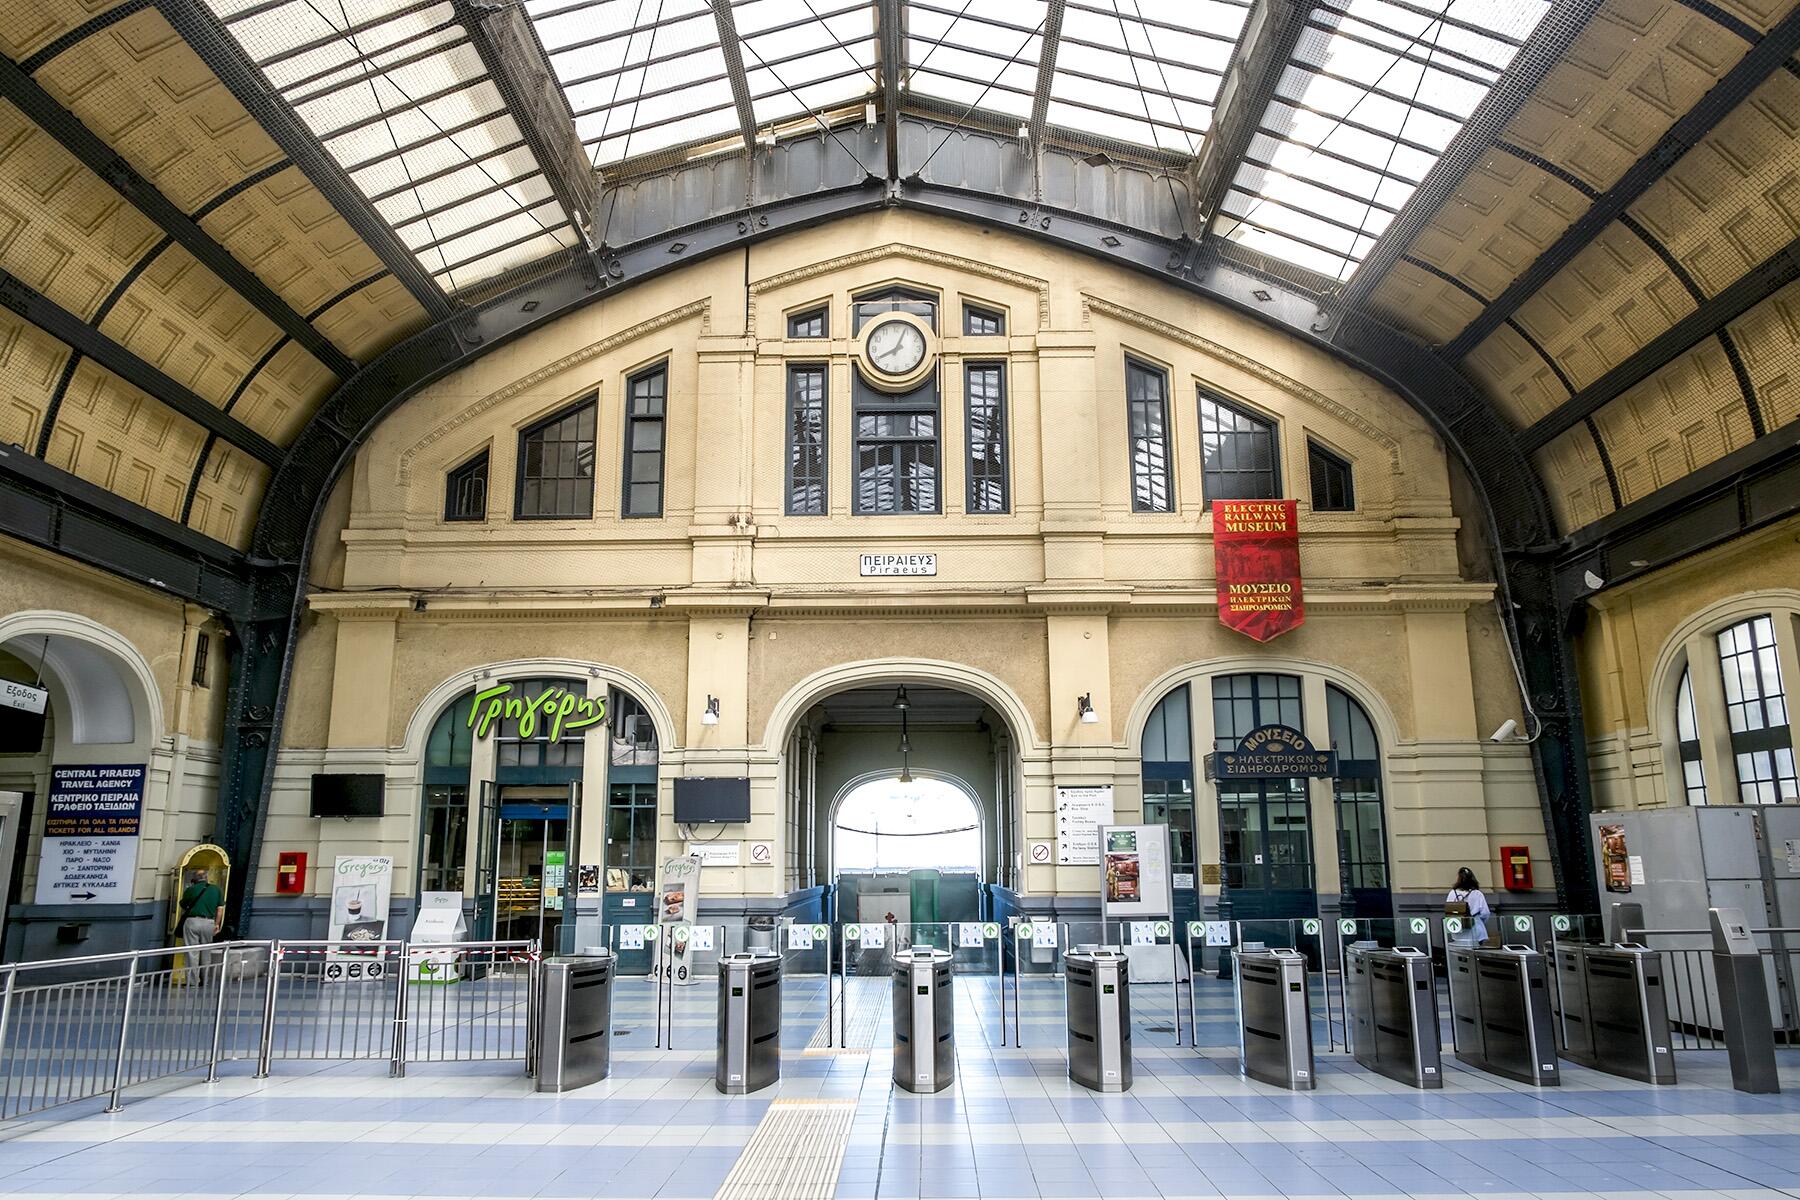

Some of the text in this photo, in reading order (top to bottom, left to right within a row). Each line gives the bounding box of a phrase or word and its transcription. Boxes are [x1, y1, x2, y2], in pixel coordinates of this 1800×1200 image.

[1224, 503, 1286, 512] ELECTRIC
[1224, 512, 1286, 520] RAILWAYS
[1225, 522, 1286, 532] MUSEUM
[864, 555, 933, 565] ΠΕΙΡΑΙΕΥΣ
[1229, 583, 1291, 594] ΜΟΥΣΕΙΟ
[467, 684, 606, 742] Γρηγόρης
[1244, 728, 1305, 751] ΜΟΥΣΕΙΟ
[1238, 755, 1313, 764] ΗΛΕΚΤΡΙΚΩΝ
[1226, 764, 1327, 773] ΣΙΔΗΡΟΔΡΟΜΩΝ
[55, 769, 141, 778] CENTRAL PIRAEUS
[61, 780, 132, 788] TRAVEL AGENCY
[51, 793, 139, 802] ΚΕΝΤΡΙΚΟ ΠΕΙΡΑΙΑ
[52, 802, 135, 811] ΓΡΑΦΕΙΟ ΤΑΞΙΔΙΩΝ
